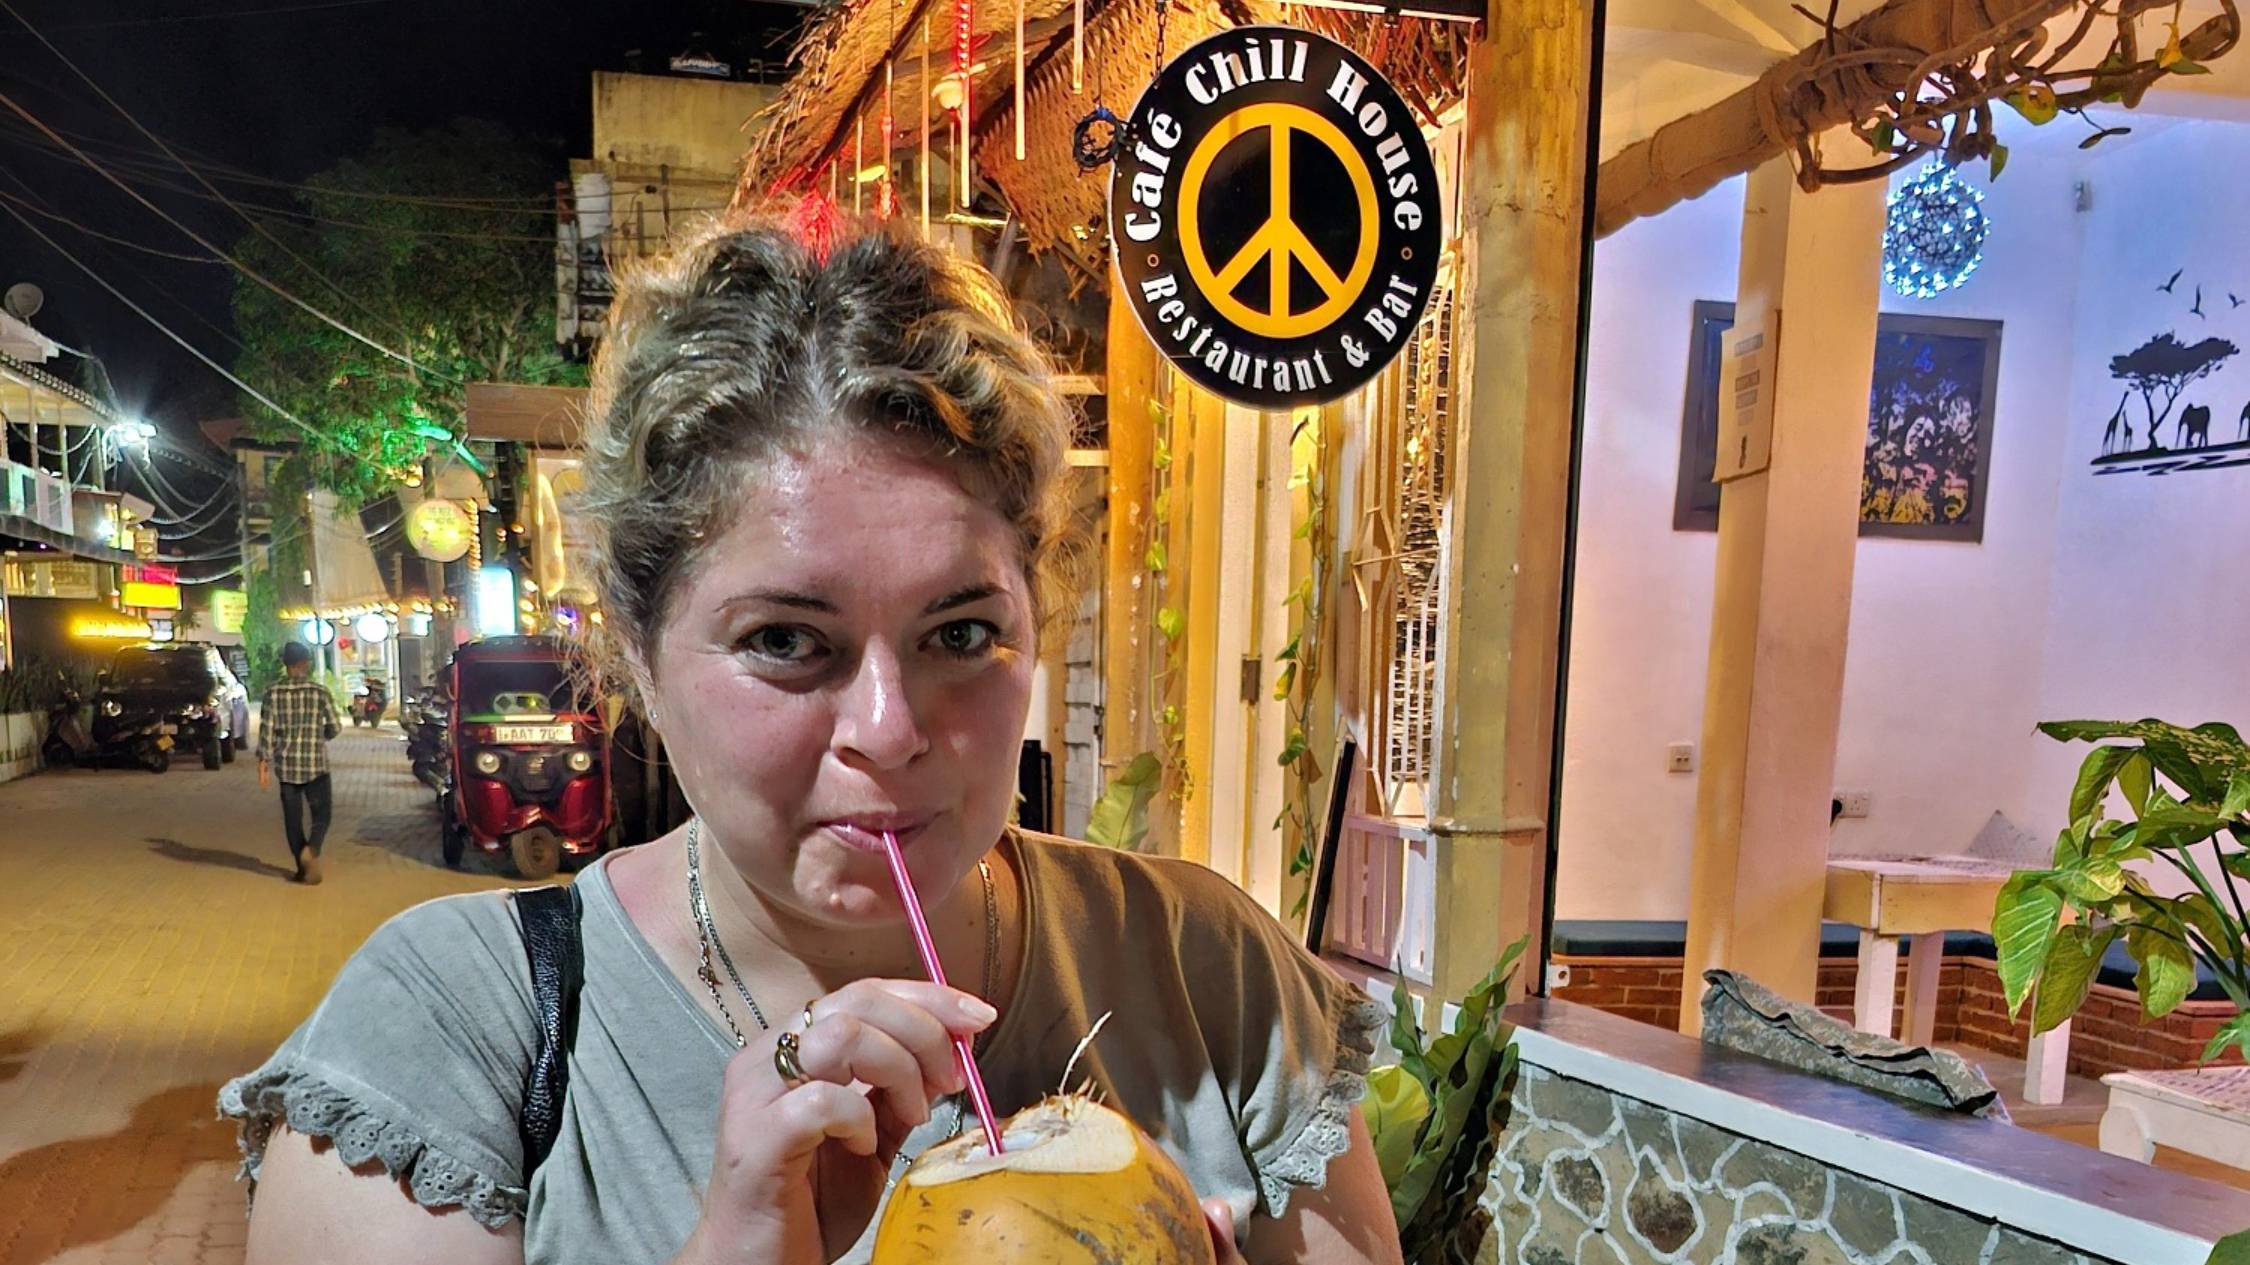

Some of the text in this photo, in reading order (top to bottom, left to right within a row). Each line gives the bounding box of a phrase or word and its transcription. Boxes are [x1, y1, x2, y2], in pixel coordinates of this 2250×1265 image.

[1125, 38, 1422, 241] Café Chill House
[1141, 273, 1417, 391] Restaurant & Bar
